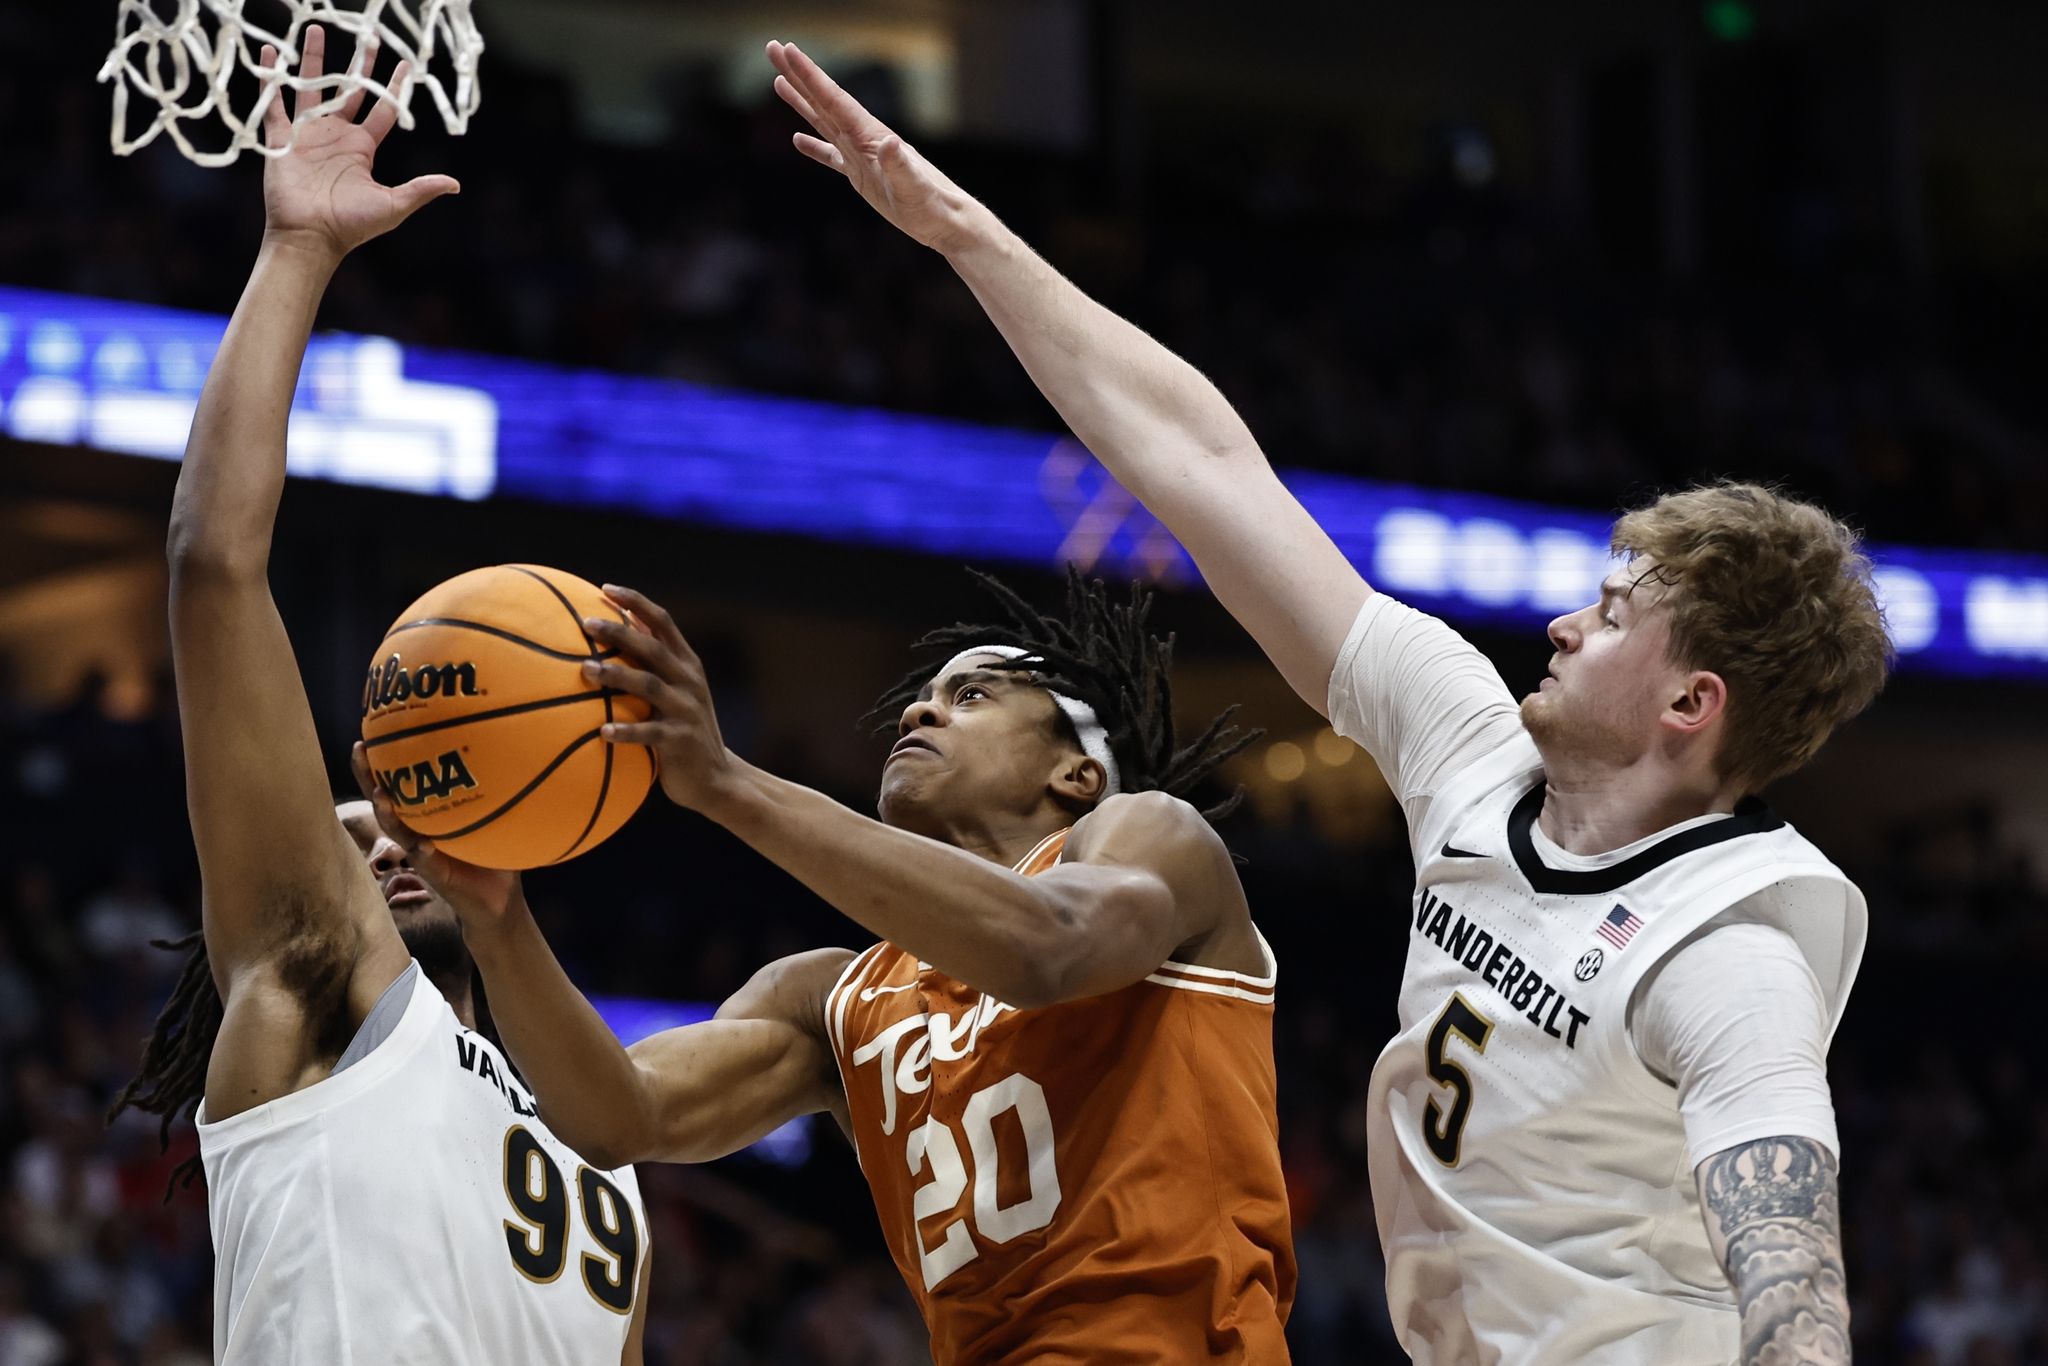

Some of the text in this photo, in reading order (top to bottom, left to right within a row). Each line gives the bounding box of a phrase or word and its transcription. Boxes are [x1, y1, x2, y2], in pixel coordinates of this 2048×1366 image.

[362, 652, 479, 714] ilson
[1416, 887, 1591, 1049] VANDERBILT
[1422, 991, 1495, 1168] 5
[503, 1123, 641, 1315] 99
[906, 1072, 1062, 1293] 20
